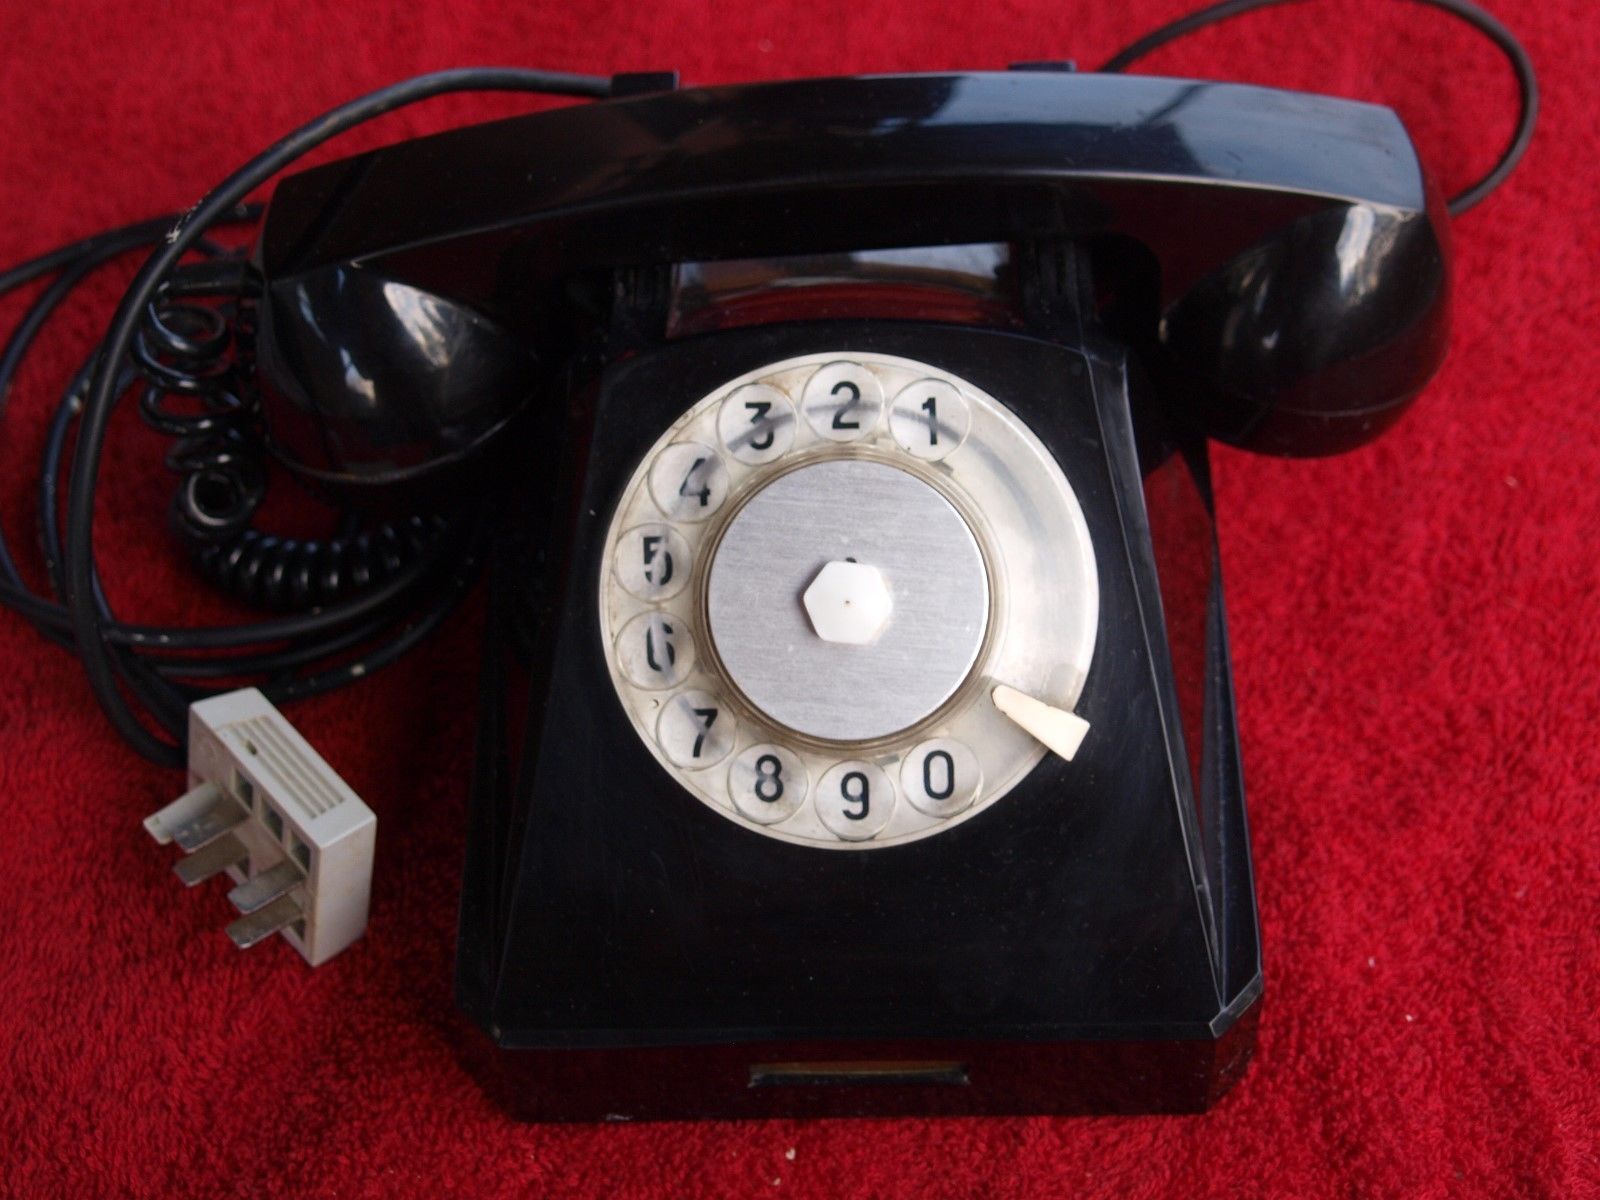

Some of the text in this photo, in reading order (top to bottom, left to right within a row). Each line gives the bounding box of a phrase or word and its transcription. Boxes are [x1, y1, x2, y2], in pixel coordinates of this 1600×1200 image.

[744, 401, 775, 451] 3
[830, 380, 861, 430] 2
[921, 396, 940, 446] 1
[678, 457, 711, 507] 4
[643, 536, 674, 587] 5
[646, 621, 676, 672] 6
[691, 707, 719, 758] 7
[754, 753, 784, 803] 8
[840, 770, 871, 821] 9
[922, 749, 956, 800] 0
